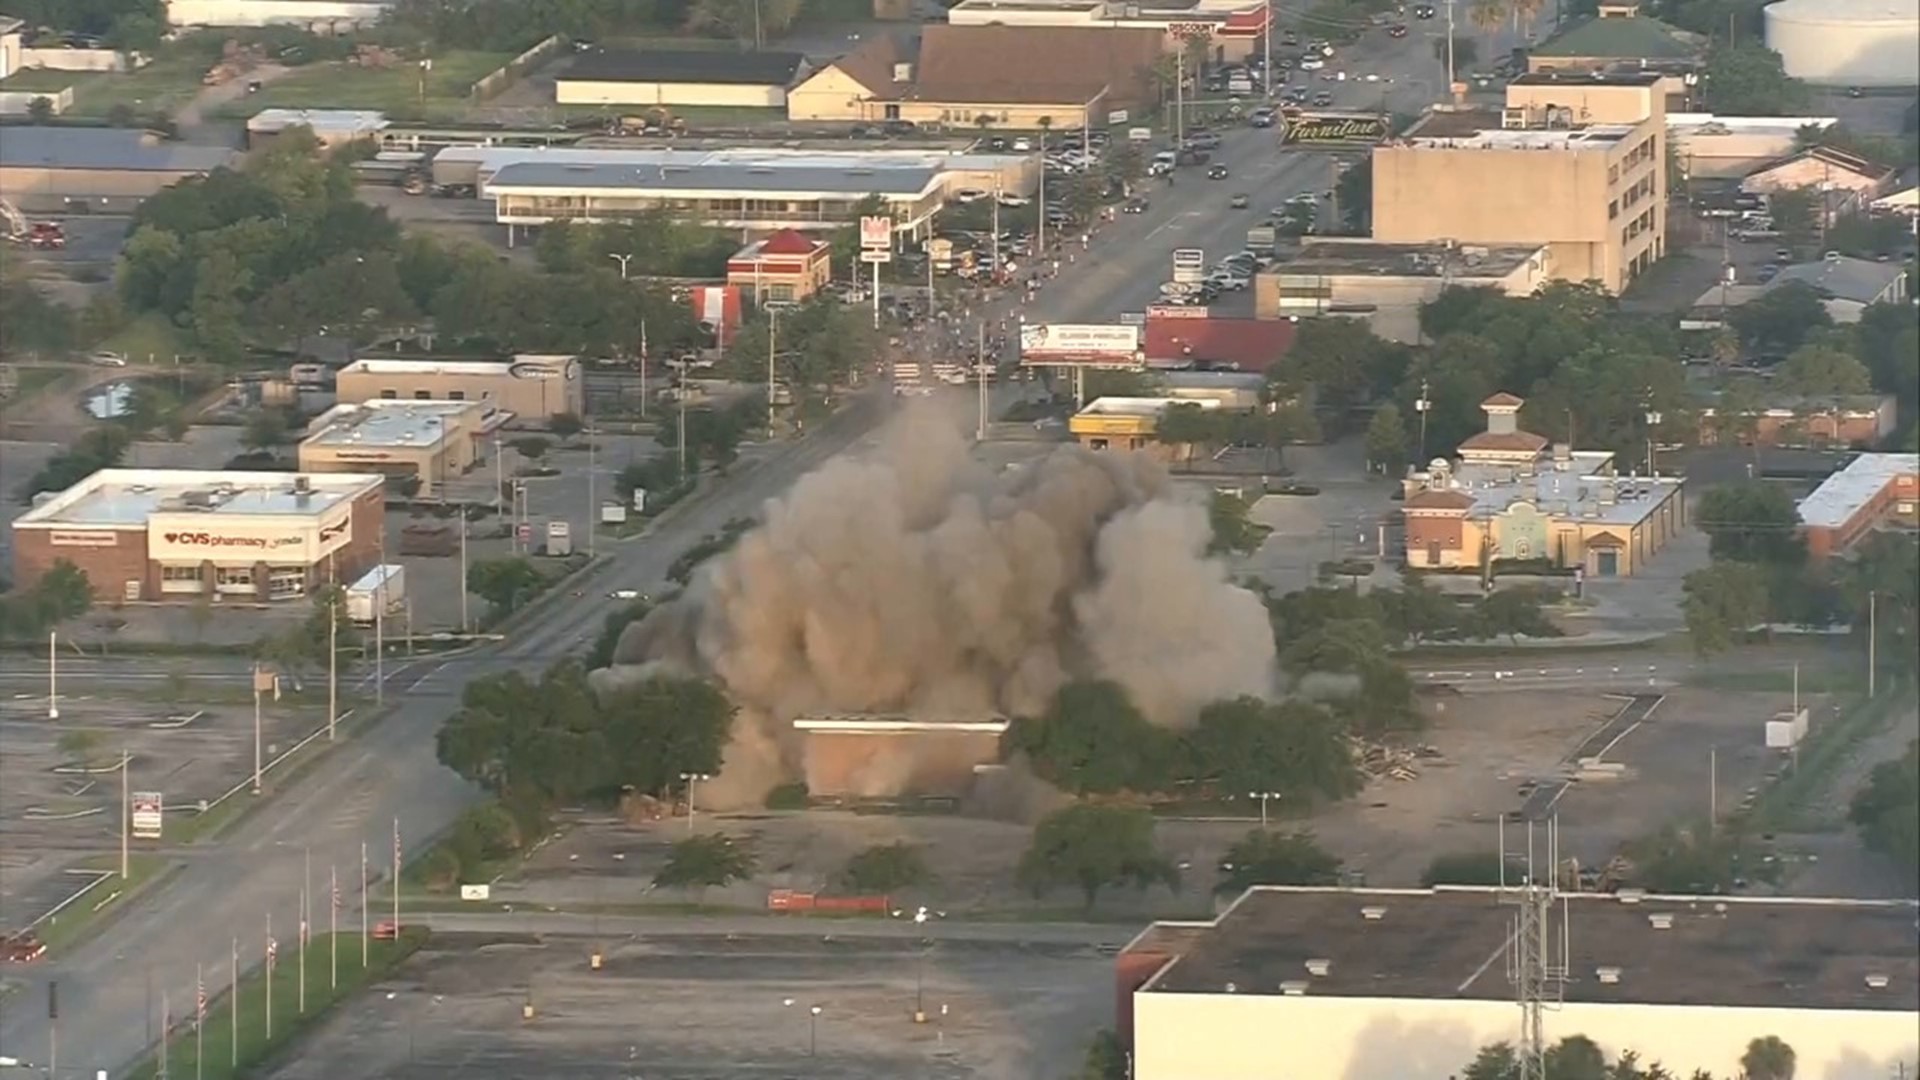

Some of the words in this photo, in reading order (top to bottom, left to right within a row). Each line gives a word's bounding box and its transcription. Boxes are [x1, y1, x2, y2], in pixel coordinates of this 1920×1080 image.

[1169, 23, 1216, 33] DISCOUNT
[1287, 119, 1378, 140] Furniture
[179, 532, 210, 545] CVS
[211, 535, 267, 549] pharmacy
